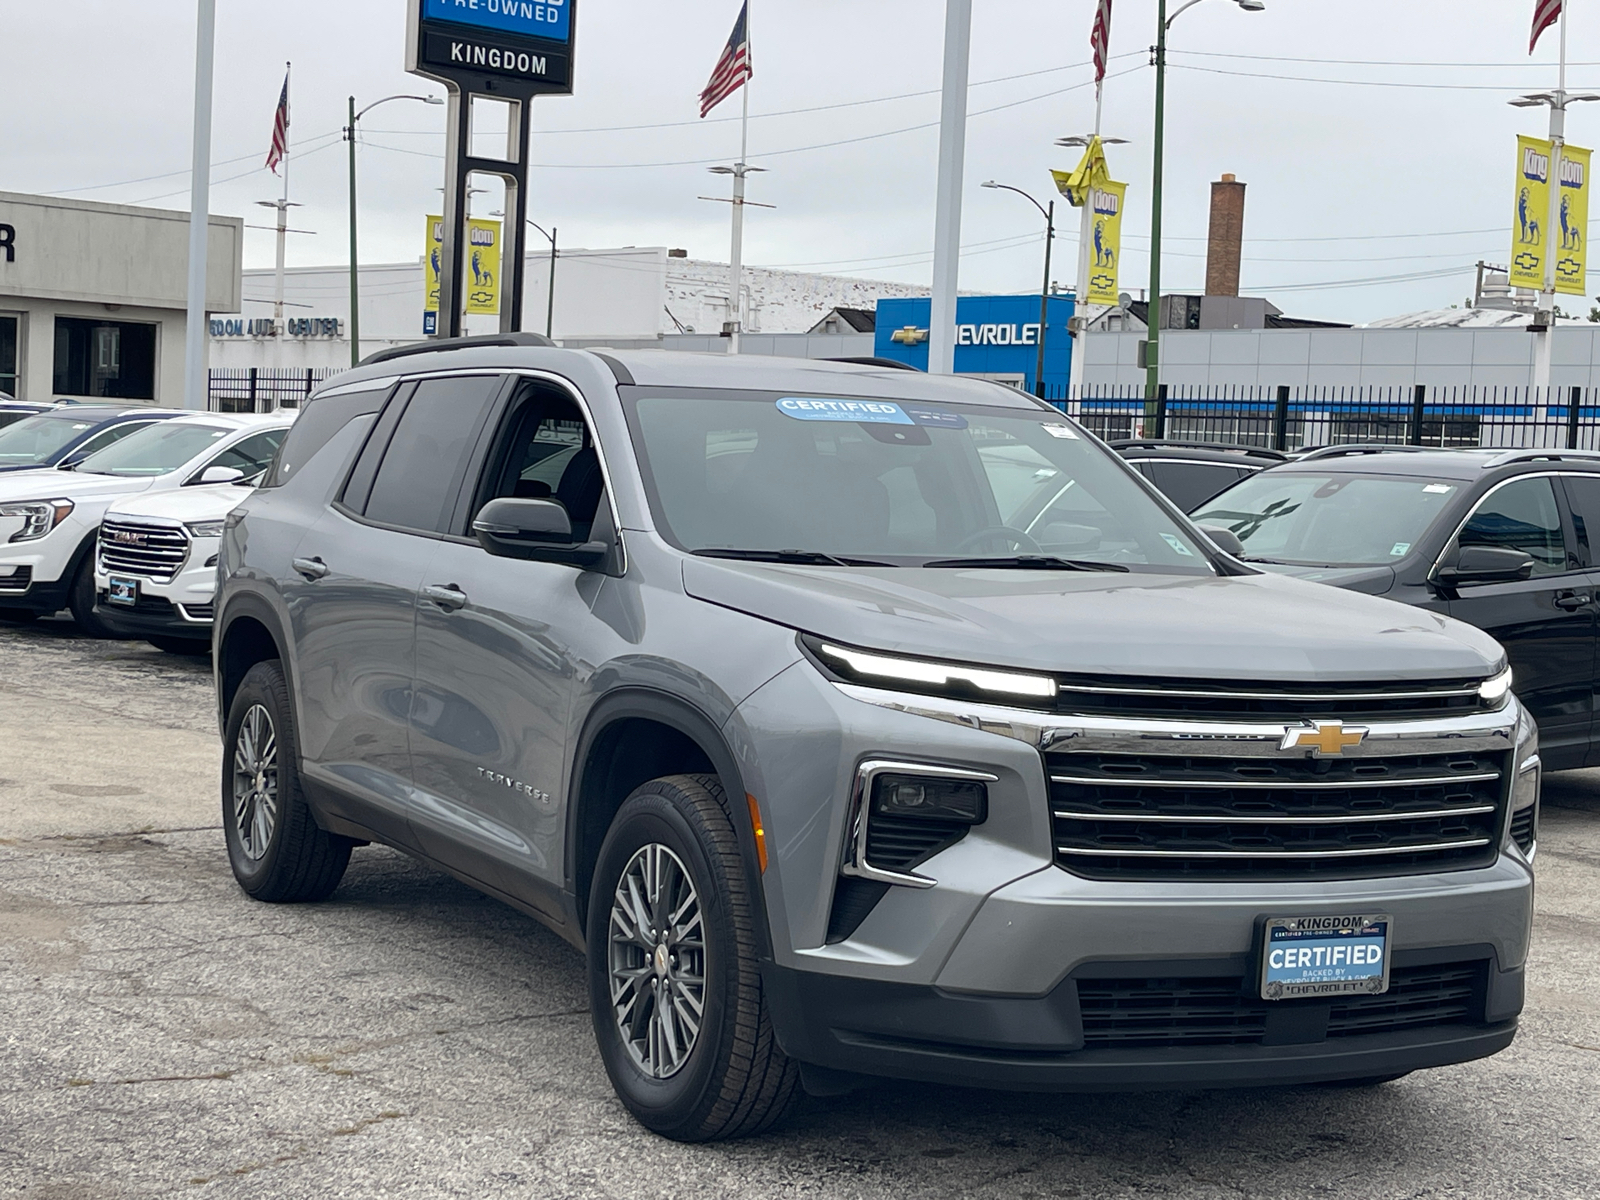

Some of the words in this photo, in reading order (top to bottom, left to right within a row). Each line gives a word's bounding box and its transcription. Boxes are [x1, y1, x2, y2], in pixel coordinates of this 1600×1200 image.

[451, 42, 547, 75] KINGDOM
[1523, 147, 1549, 181] King
[1560, 156, 1584, 185] dom
[1094, 188, 1119, 213] dom
[471, 226, 494, 244] dom
[288, 318, 342, 337] CENTER
[781, 400, 897, 415] CERTIFIED
[477, 766, 551, 804] TRAVERSE
[1296, 916, 1363, 930] KINGDOM
[1269, 944, 1382, 969] CERTIFIED
[1302, 969, 1333, 978] BACKED
[1335, 968, 1346, 976] BY
[1291, 982, 1358, 994] CHEVROLET
